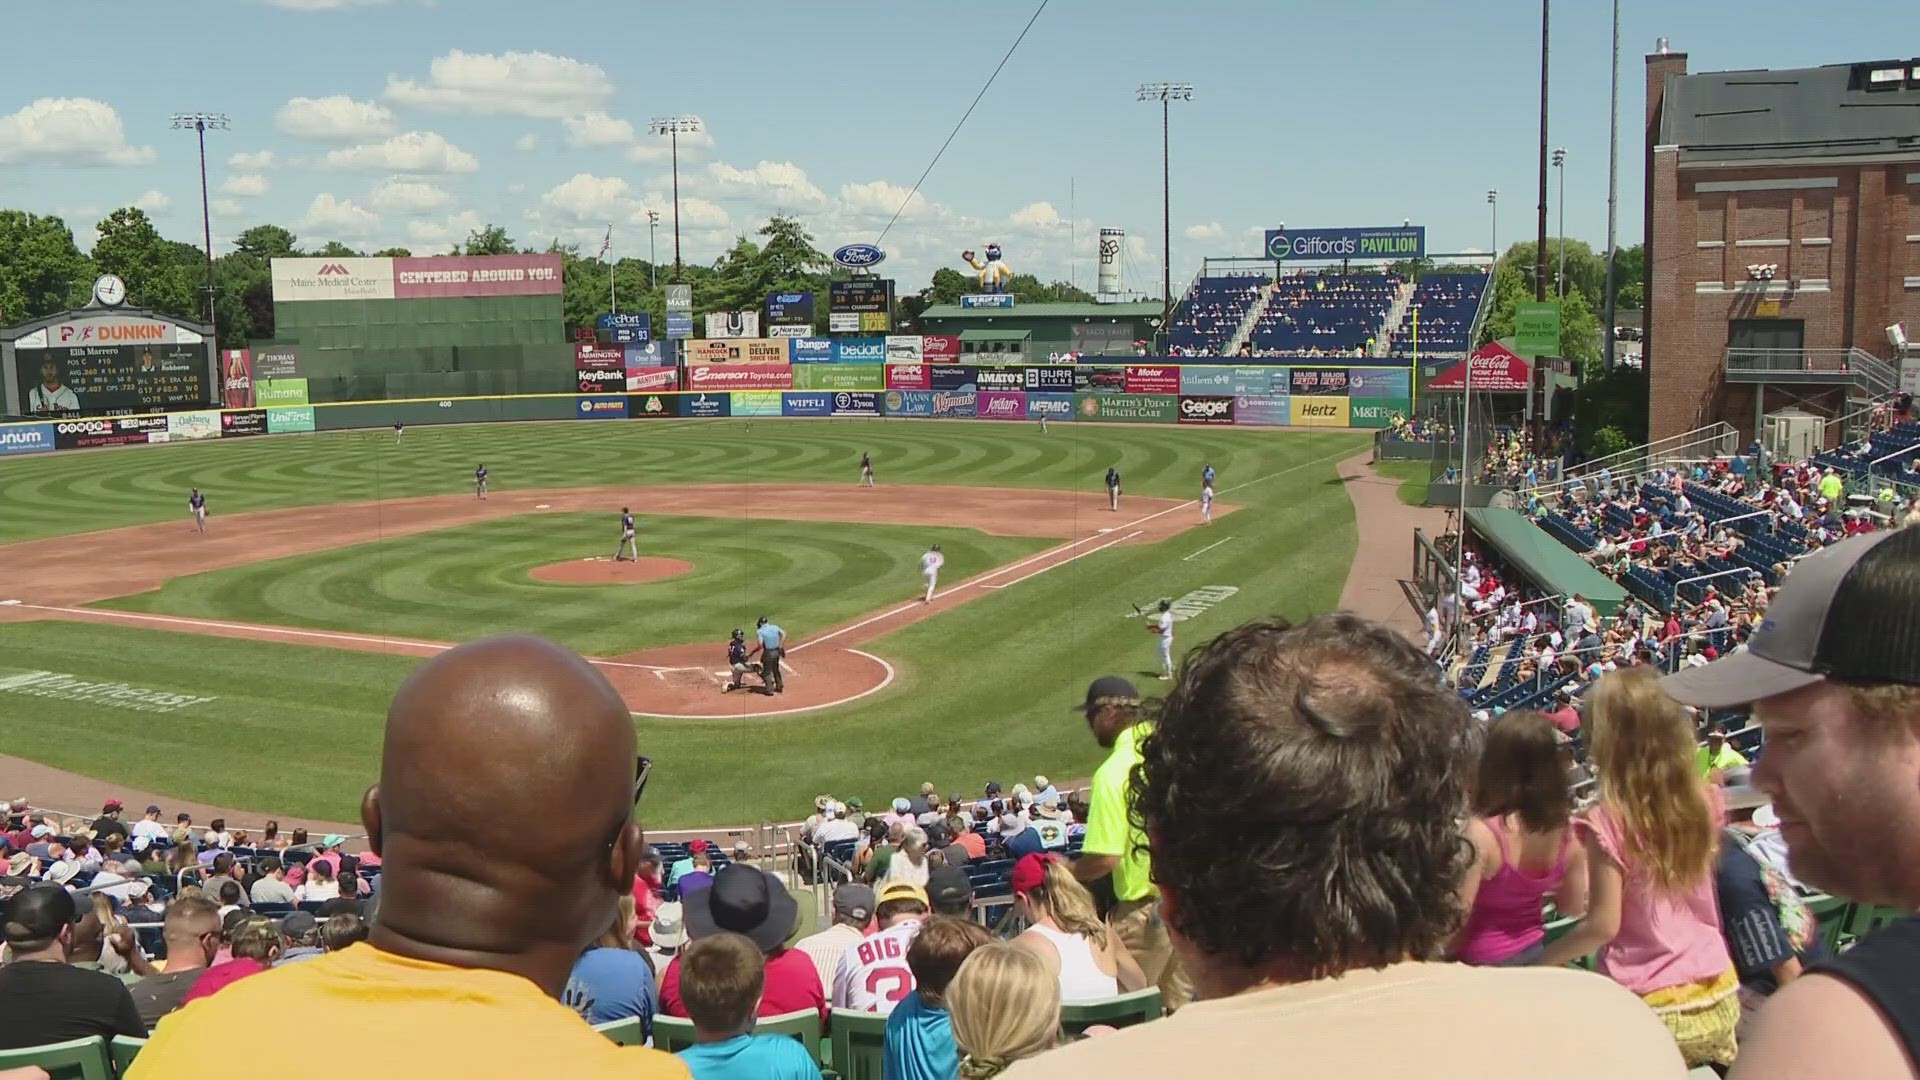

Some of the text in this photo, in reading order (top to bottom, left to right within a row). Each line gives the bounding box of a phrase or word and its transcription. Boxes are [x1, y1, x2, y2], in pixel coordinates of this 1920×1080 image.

[1293, 237, 1355, 255] Gifford's
[1361, 238, 1418, 253] PAVILION
[843, 248, 873, 263] Ford
[399, 268, 557, 284] CENTERED AROUND YOU.
[291, 277, 377, 288] Maine Medical Center
[614, 314, 640, 324] cPort
[780, 327, 807, 335] Norway
[864, 320, 886, 331] JOE
[98, 325, 166, 340] DUNKIN'
[638, 330, 648, 340] 93
[796, 339, 831, 350] Bangor
[840, 342, 883, 356] bedard
[70, 347, 119, 356] Elih Marrero
[578, 351, 621, 360] FARMINGTON
[749, 347, 780, 355] DELIVER
[267, 353, 295, 362] THOMAS
[578, 369, 624, 382] KeyBank
[693, 367, 792, 381] Emerson Toyota.com
[1137, 368, 1163, 376] Motor
[977, 373, 1023, 383] AMATO'S
[1182, 374, 1213, 384] Anthem
[1293, 377, 1346, 385] FUN FUN
[259, 389, 304, 399] Humana
[745, 393, 780, 401] Spectrum
[903, 391, 930, 402] MANN
[787, 399, 825, 407] WIPFLI
[852, 400, 874, 408] Tyson
[906, 402, 925, 412] LAW
[932, 392, 976, 413] Wyman's
[984, 397, 1019, 413] Jordan's
[1030, 401, 1070, 412] MEMIC
[1102, 398, 1171, 407] MARTIN'S POINT
[1181, 400, 1230, 416] Geiger
[106, 408, 134, 416] STRIKE
[1102, 408, 1161, 417] HEALTH CARE
[1302, 404, 1337, 416] Hertz
[1352, 406, 1406, 418] M&T Bank
[139, 418, 166, 427] MILLION
[271, 411, 310, 423] UniFirst
[58, 421, 104, 434] POWER
[0, 432, 41, 445] unum
[107, 435, 127, 443] TICKET
[857, 937, 901, 966] BIG
